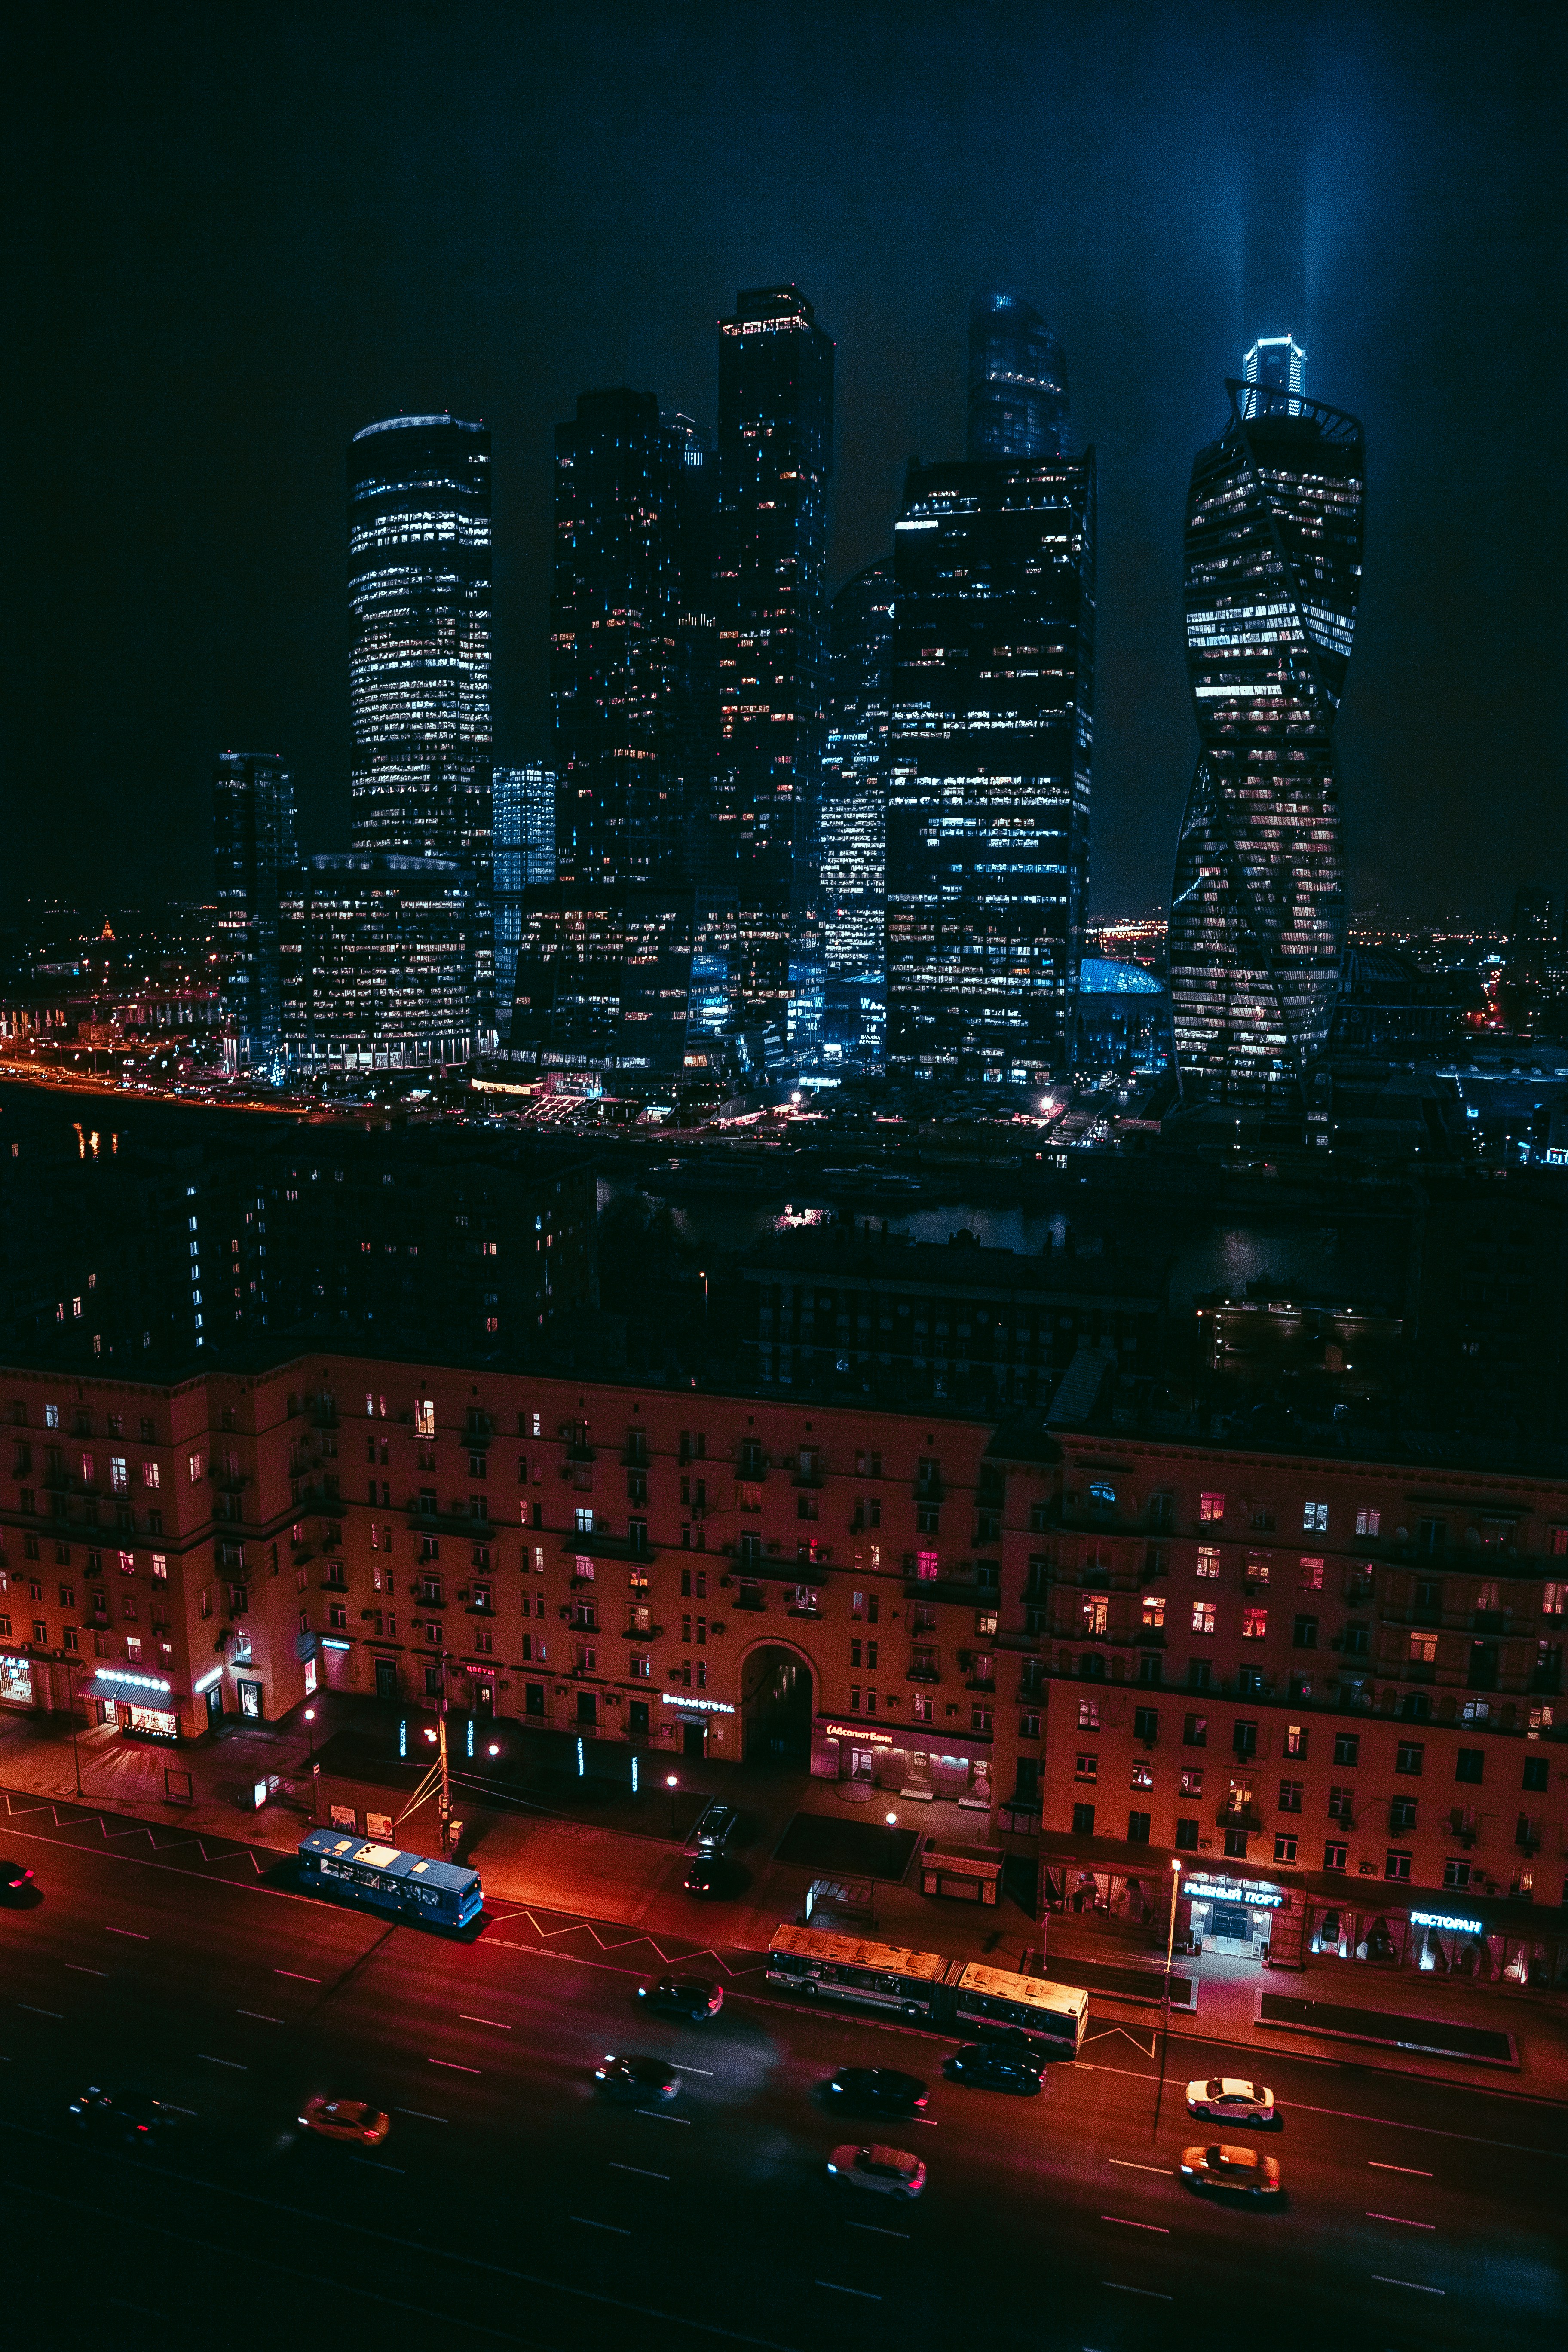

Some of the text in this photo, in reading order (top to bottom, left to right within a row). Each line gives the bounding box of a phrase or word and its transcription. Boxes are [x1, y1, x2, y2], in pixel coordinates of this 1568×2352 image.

[18, 1659, 29, 1670] 24
[830, 1726, 893, 1743] Абсолют Банк
[1184, 1882, 1283, 1907] РЫБНЫЙ ПОРТ
[1410, 1911, 1482, 1934] РЕСТОРАН
